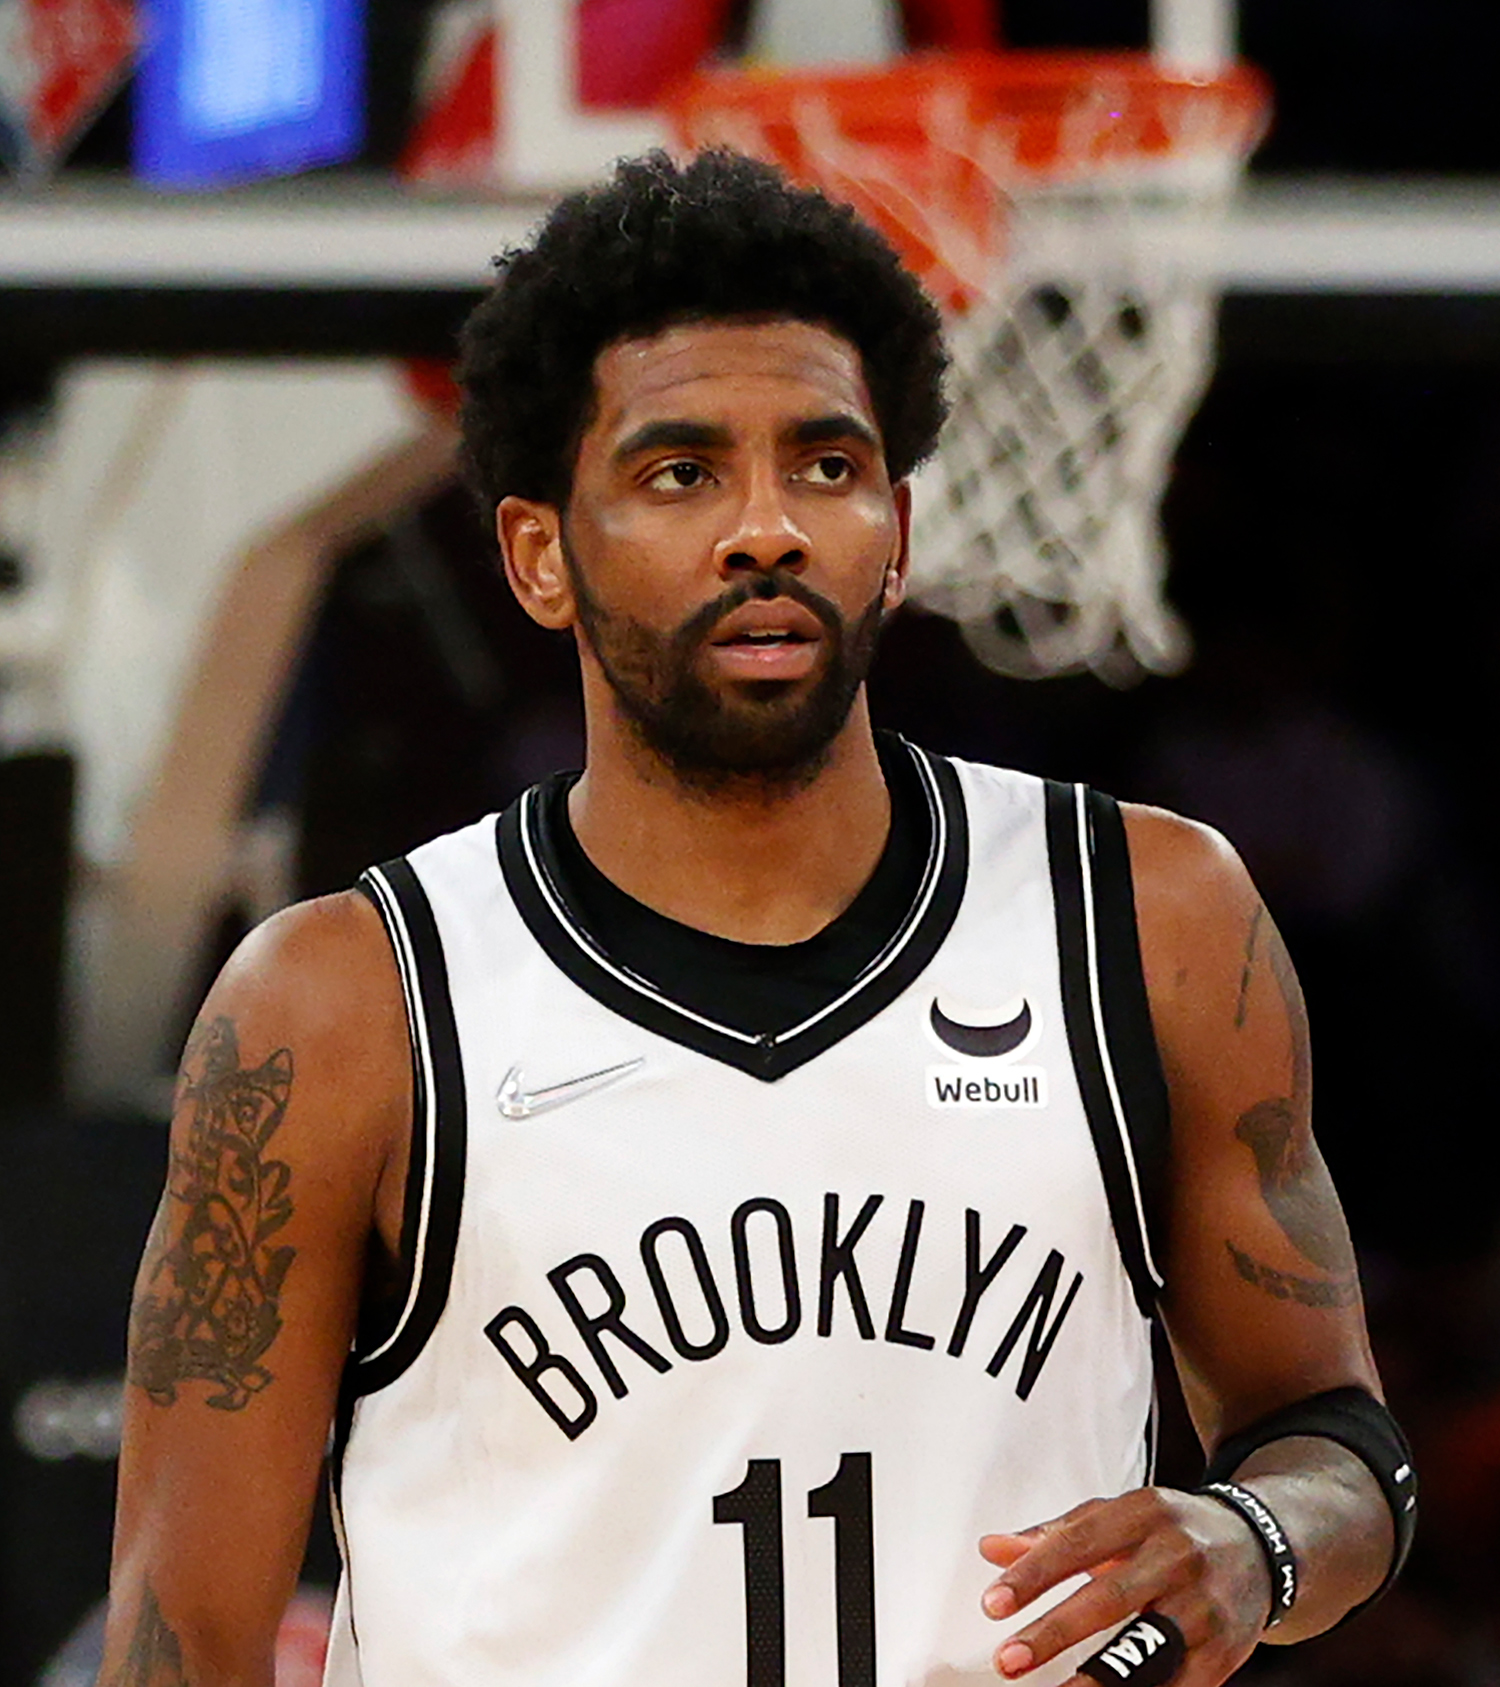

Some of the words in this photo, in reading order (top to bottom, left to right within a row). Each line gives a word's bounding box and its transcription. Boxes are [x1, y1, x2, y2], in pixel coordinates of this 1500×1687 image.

[934, 1076, 1039, 1103] Webull
[484, 1192, 1084, 1442] BROOKLYN
[1208, 1482, 1287, 1554] HUMAN
[712, 1451, 877, 1687] 11
[1099, 1621, 1167, 1679] KAI
